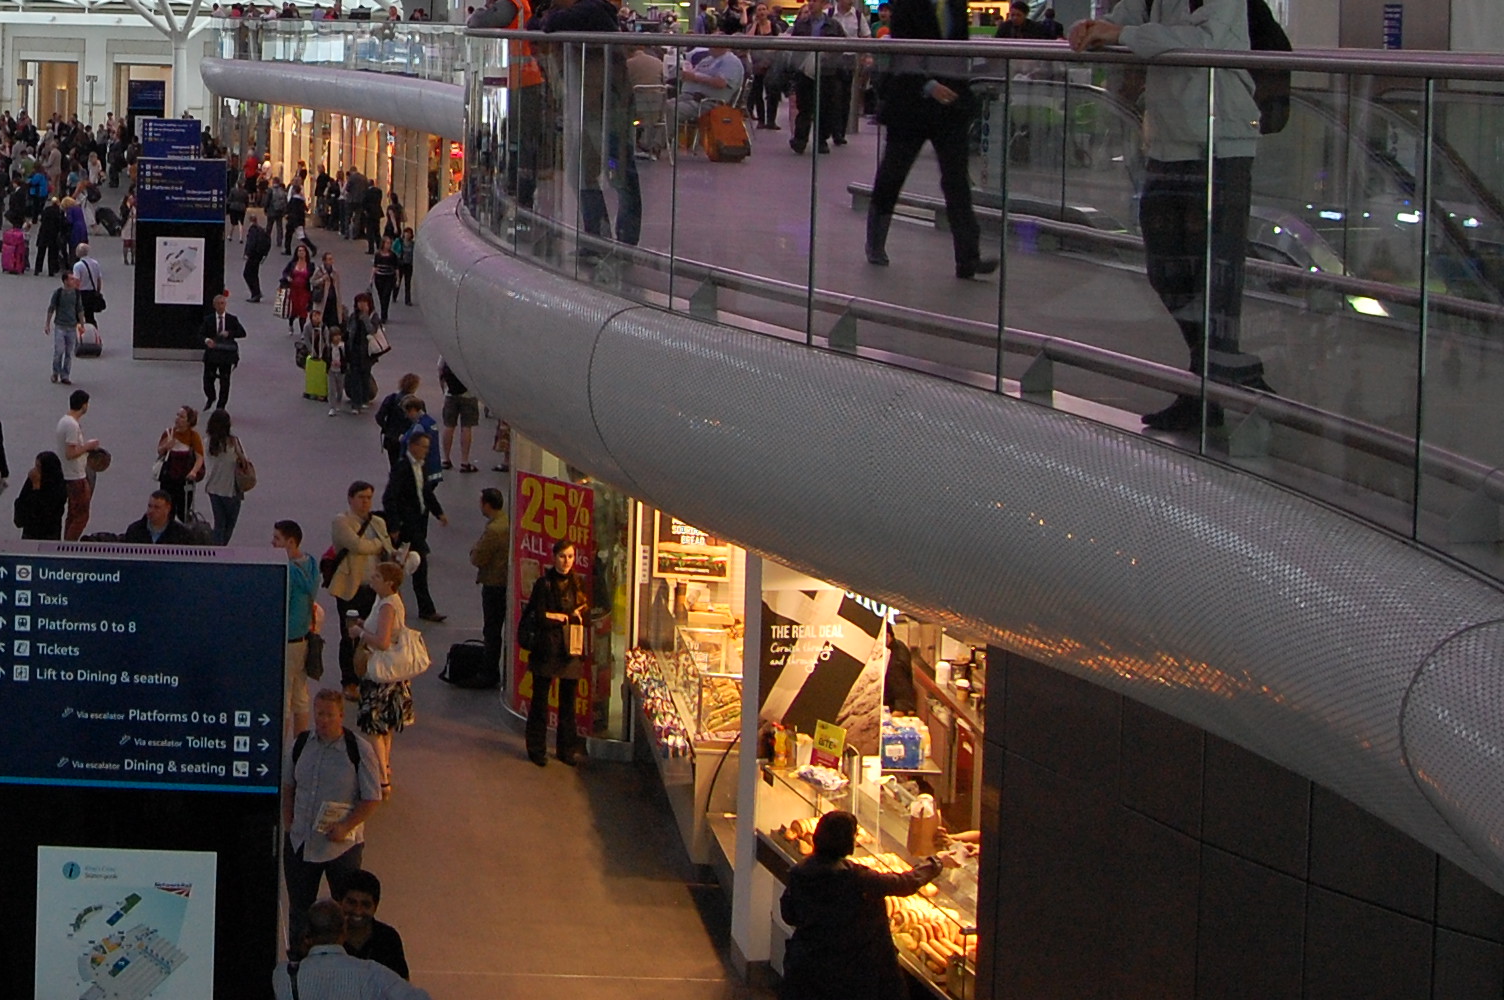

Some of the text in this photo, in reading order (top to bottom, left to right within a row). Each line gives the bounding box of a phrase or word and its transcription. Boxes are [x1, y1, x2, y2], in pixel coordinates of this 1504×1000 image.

[520, 477, 590, 539] 25%
[568, 525, 589, 545] OFF
[520, 533, 547, 556] ALL
[38, 567, 120, 584] Underground
[37, 592, 68, 606] Taxis
[37, 617, 136, 633] Platforms 0 to 8
[771, 624, 845, 639] THE REAL DEAL
[37, 642, 80, 657] Tickets
[769, 642, 800, 654] Cornish
[769, 654, 786, 666] and
[36, 668, 179, 688] Lift to Dining & seating
[76, 708, 227, 725] Via escalator Platforms 0 to 8
[134, 735, 226, 749] Via escalator Toilets
[72, 758, 226, 777] Via escalator Dining & seating
